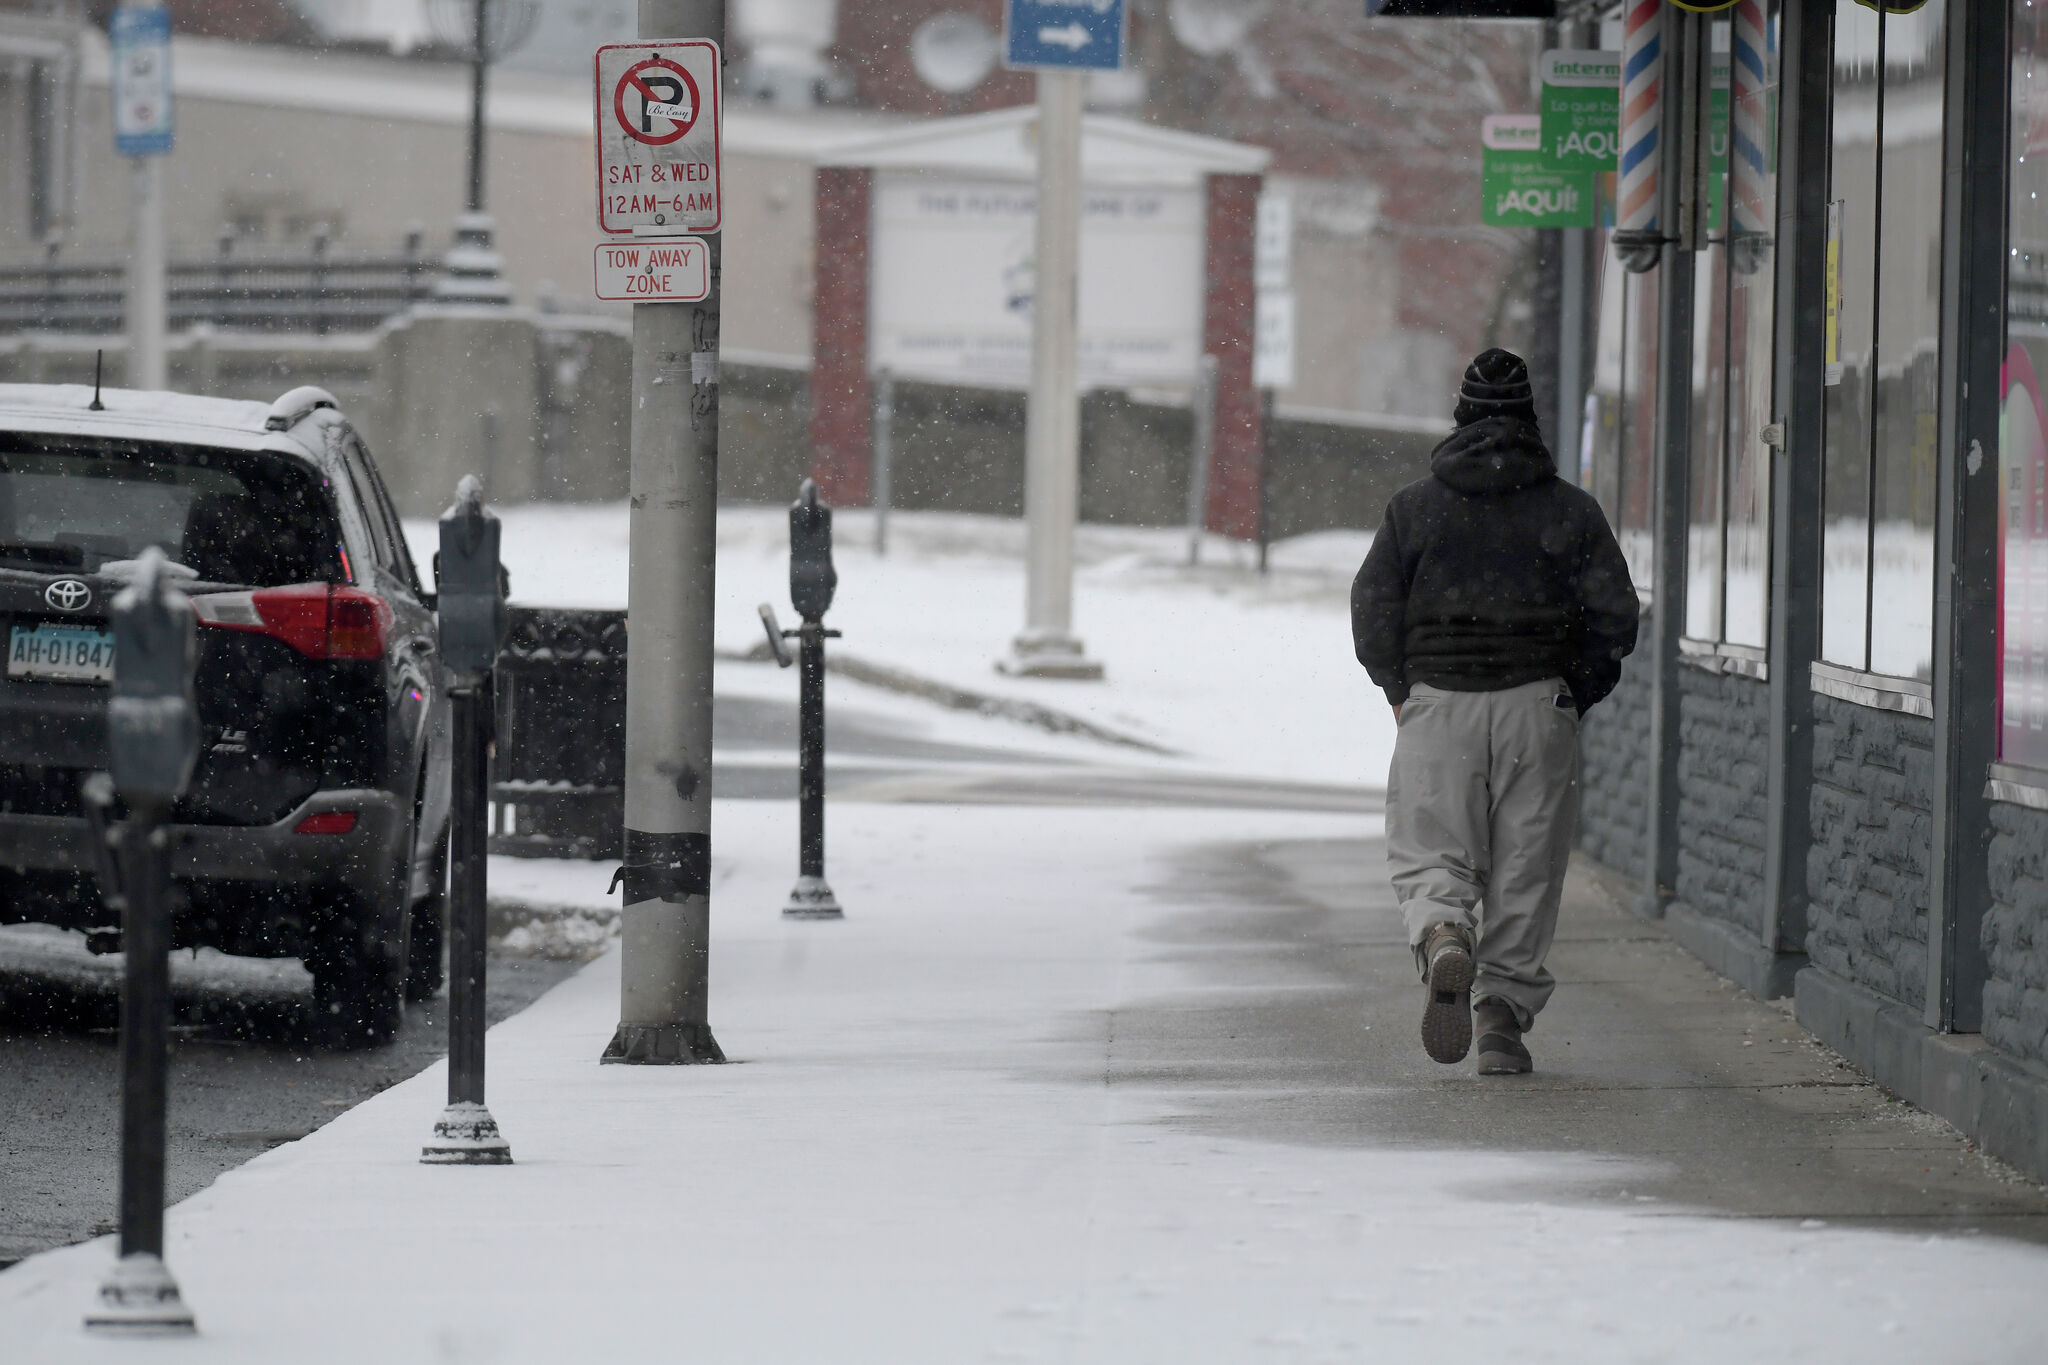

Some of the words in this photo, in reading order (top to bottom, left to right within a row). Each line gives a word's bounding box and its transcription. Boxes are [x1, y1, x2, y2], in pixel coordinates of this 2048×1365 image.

[1553, 61, 1622, 76] interm
[648, 104, 664, 116] Be
[666, 105, 689, 119] Easy
[609, 165, 642, 184] SAT
[651, 165, 665, 182] &
[671, 163, 709, 182] WED
[966, 194, 1037, 217] FUTUR
[606, 250, 640, 268] TOW
[649, 249, 691, 267] AWAY
[626, 275, 672, 293] ZONE
